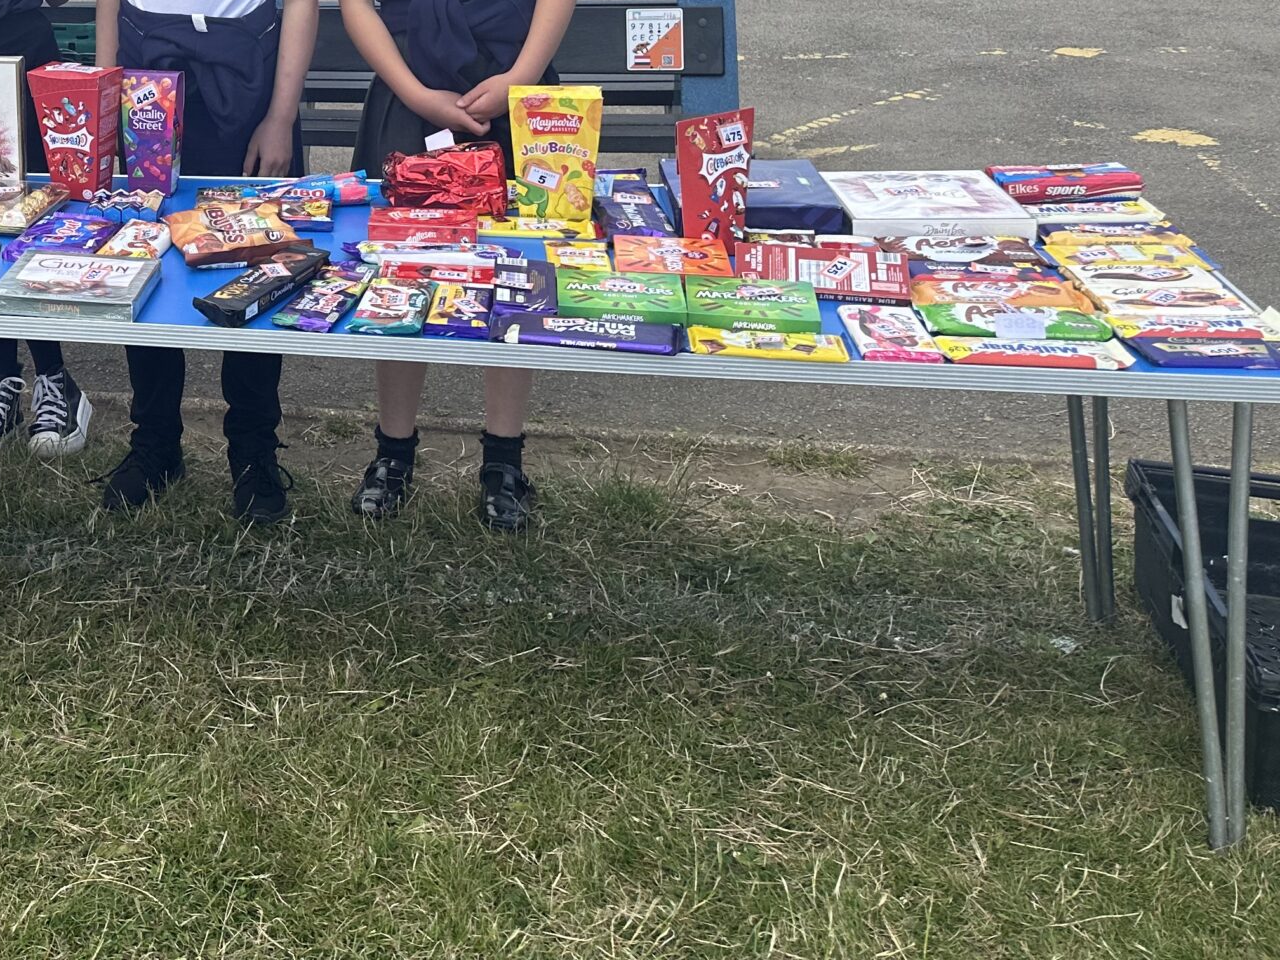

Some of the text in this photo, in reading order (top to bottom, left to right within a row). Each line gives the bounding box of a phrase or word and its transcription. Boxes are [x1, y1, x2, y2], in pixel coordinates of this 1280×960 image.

[136, 90, 156, 106] 445
[129, 108, 166, 122] Quality
[133, 120, 163, 131] Street
[527, 115, 580, 131] Maynards
[725, 131, 743, 142] 475
[538, 174, 546, 184] 5
[1008, 184, 1039, 195] Elkes
[1045, 185, 1087, 196] sports
[826, 259, 847, 275] 125
